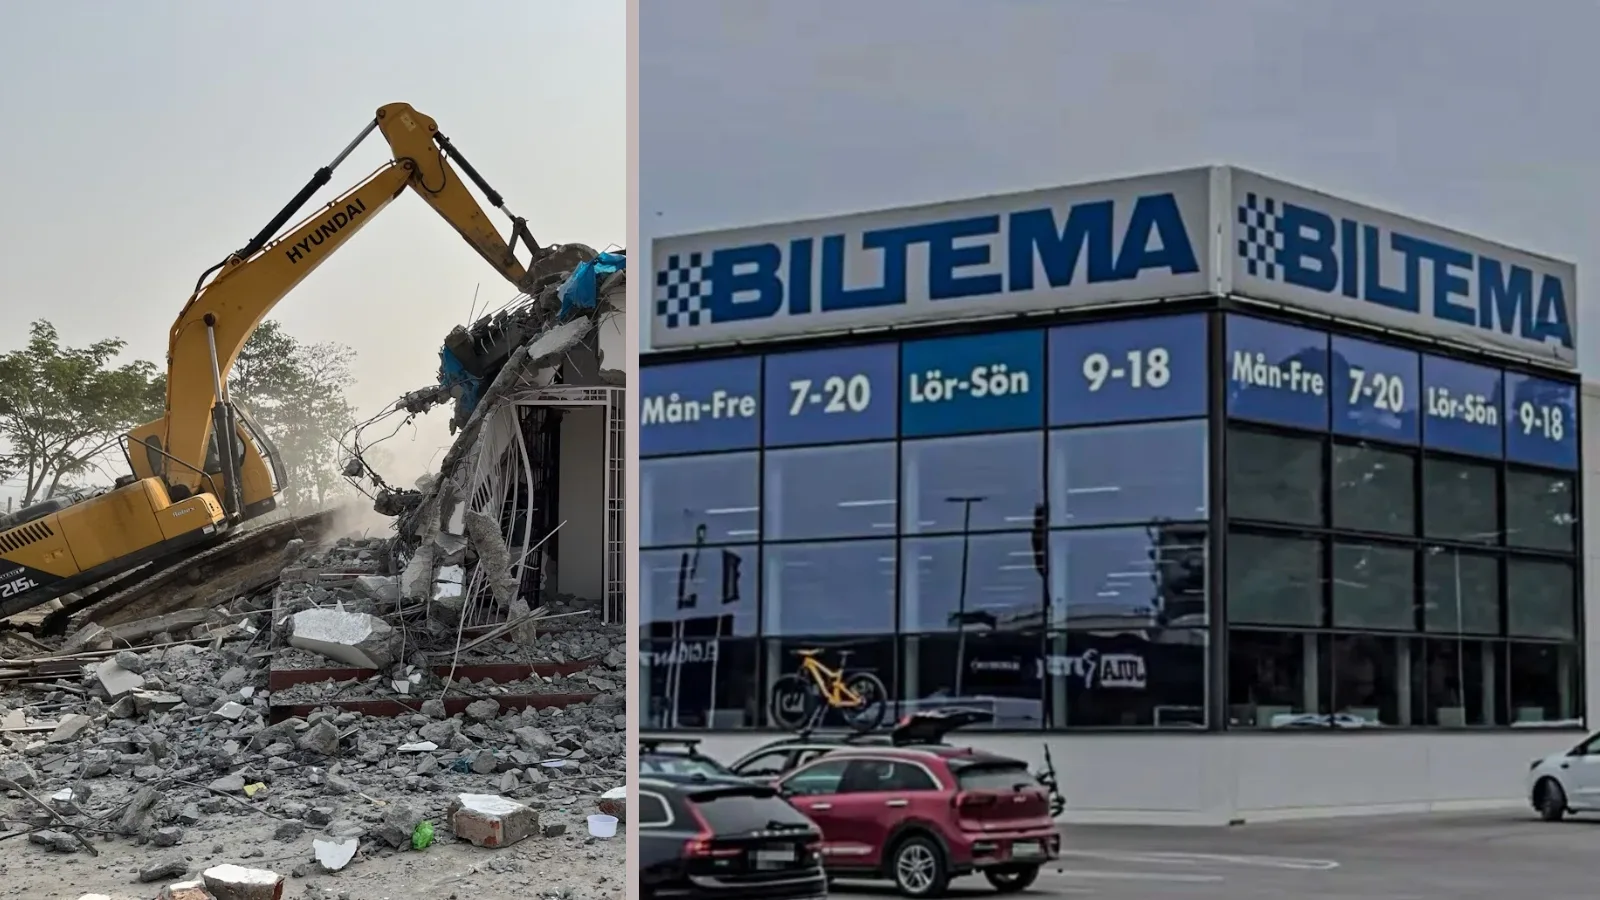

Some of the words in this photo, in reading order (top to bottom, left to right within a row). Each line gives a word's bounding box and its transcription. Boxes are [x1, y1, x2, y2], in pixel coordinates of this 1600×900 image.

[285, 198, 366, 264] HYUNDAI
[710, 193, 1200, 324] BILTEMA
[1282, 202, 1575, 349] BILTEMA
[641, 389, 757, 426] Mån-Fre
[789, 374, 871, 416] 7-20
[909, 365, 1029, 404] Lör-Sön
[1082, 348, 1171, 391] 9-18
[1232, 351, 1325, 396] Mån-Fre
[1349, 369, 1404, 413] 7-20
[1428, 387, 1497, 426] Lör-Sön
[1519, 402, 1564, 441] 9-18
